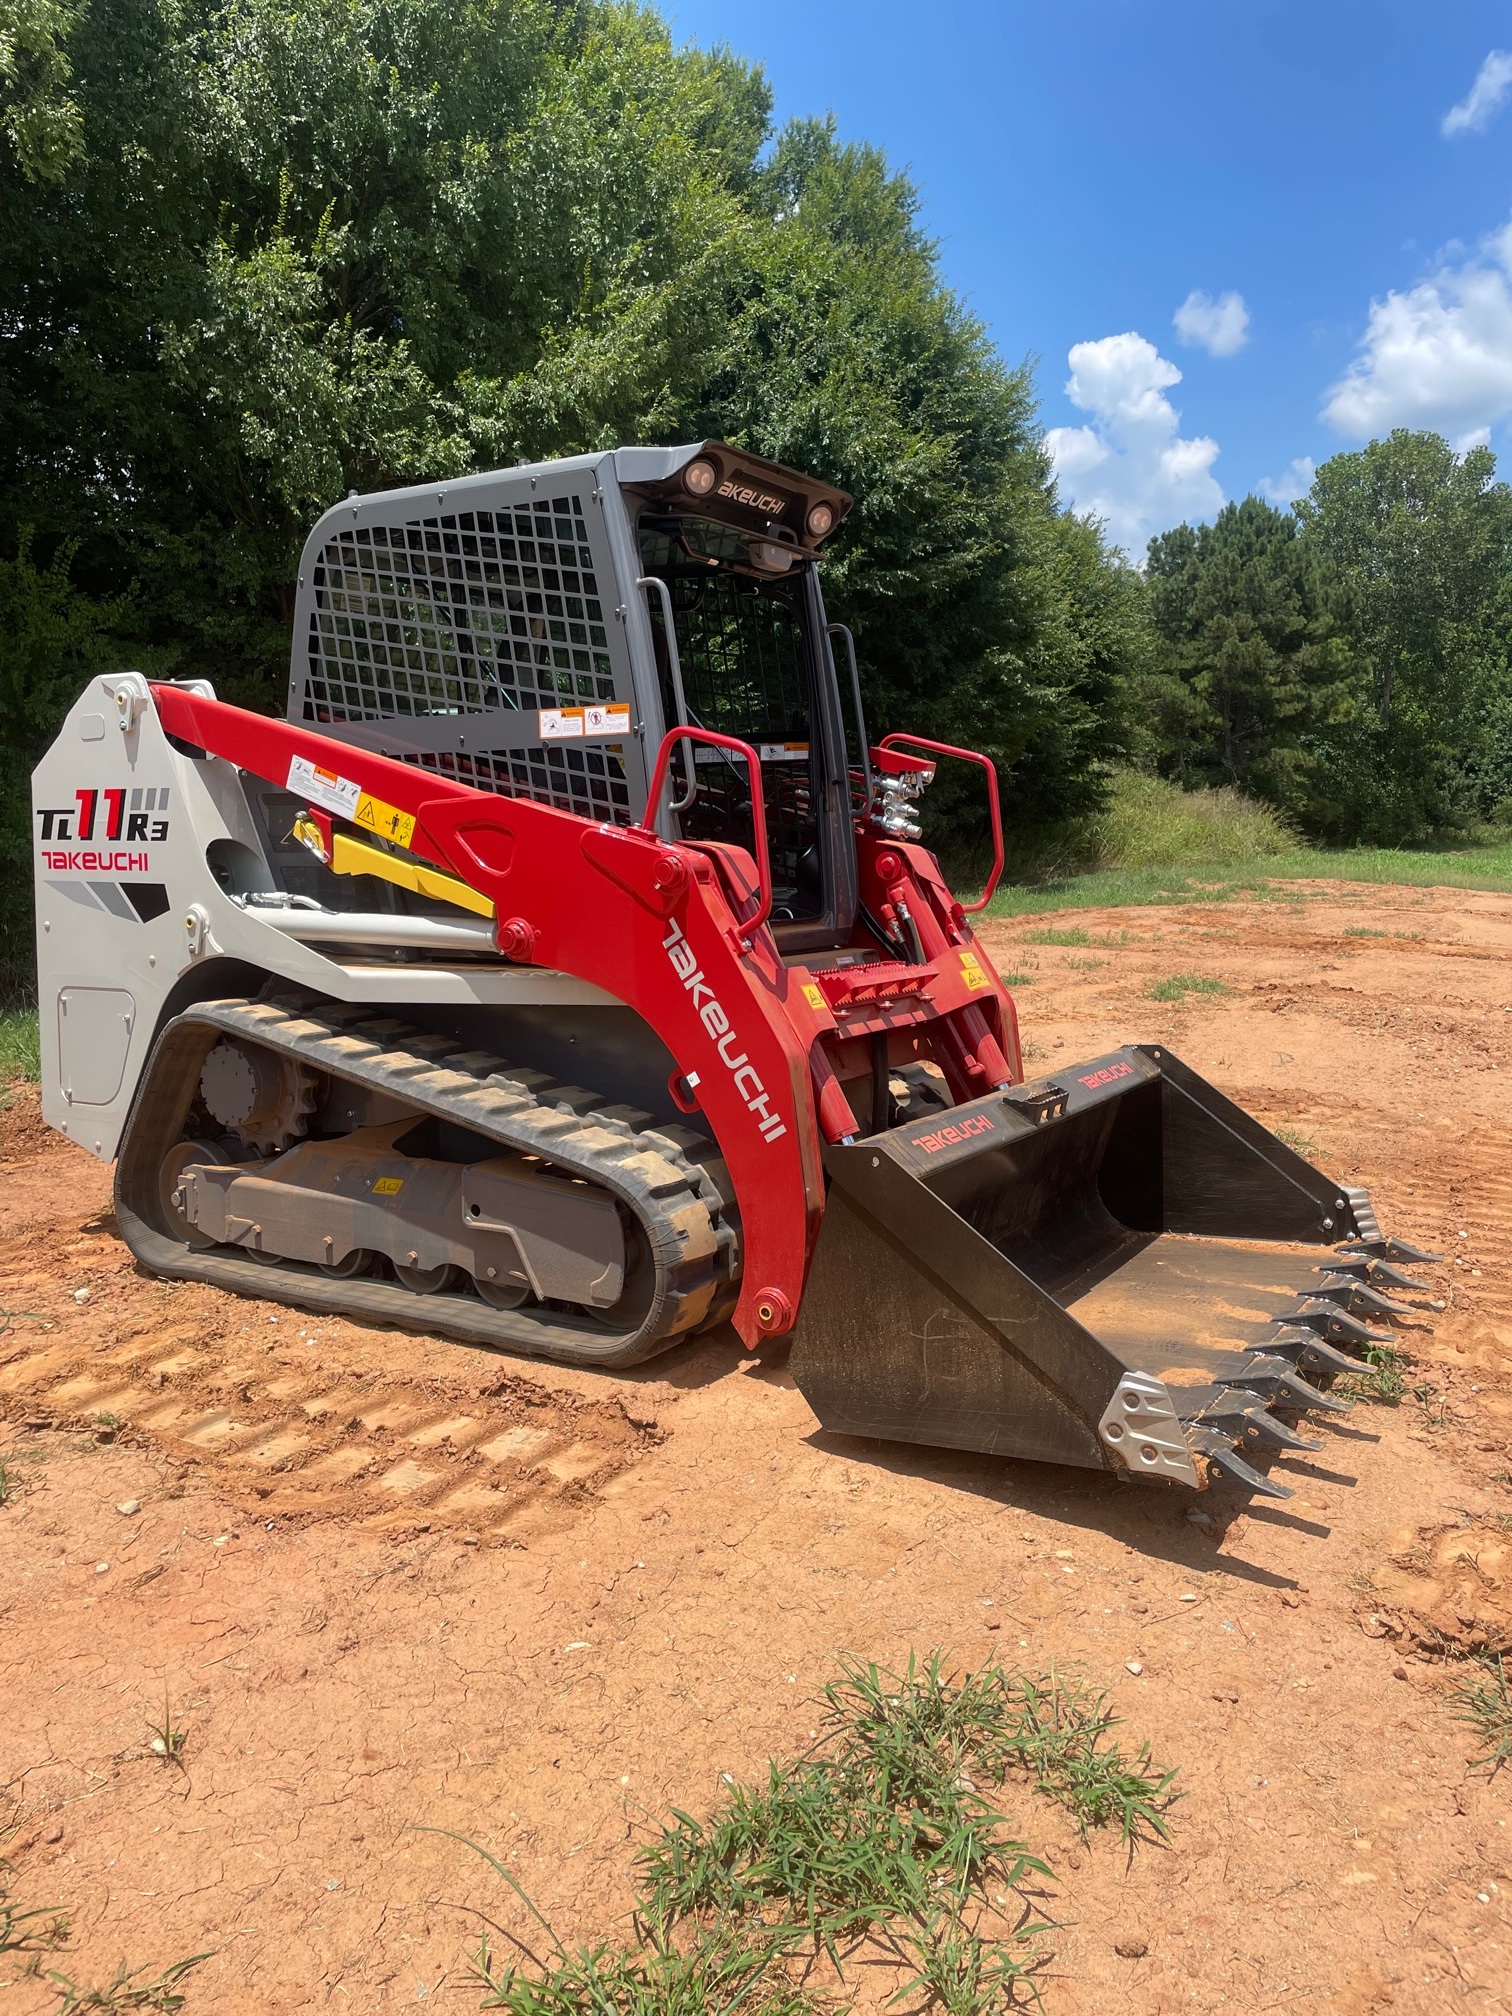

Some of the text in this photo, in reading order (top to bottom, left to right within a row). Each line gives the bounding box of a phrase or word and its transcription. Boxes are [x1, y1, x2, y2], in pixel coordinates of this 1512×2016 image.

[715, 481, 786, 515] AKEUCHI
[41, 851, 149, 872] TAKEUCHI
[661, 916, 787, 1144] TAKEUCHI
[1077, 1061, 1134, 1090] TAKEUCHI
[911, 1113, 995, 1154] TAKEUCHI
